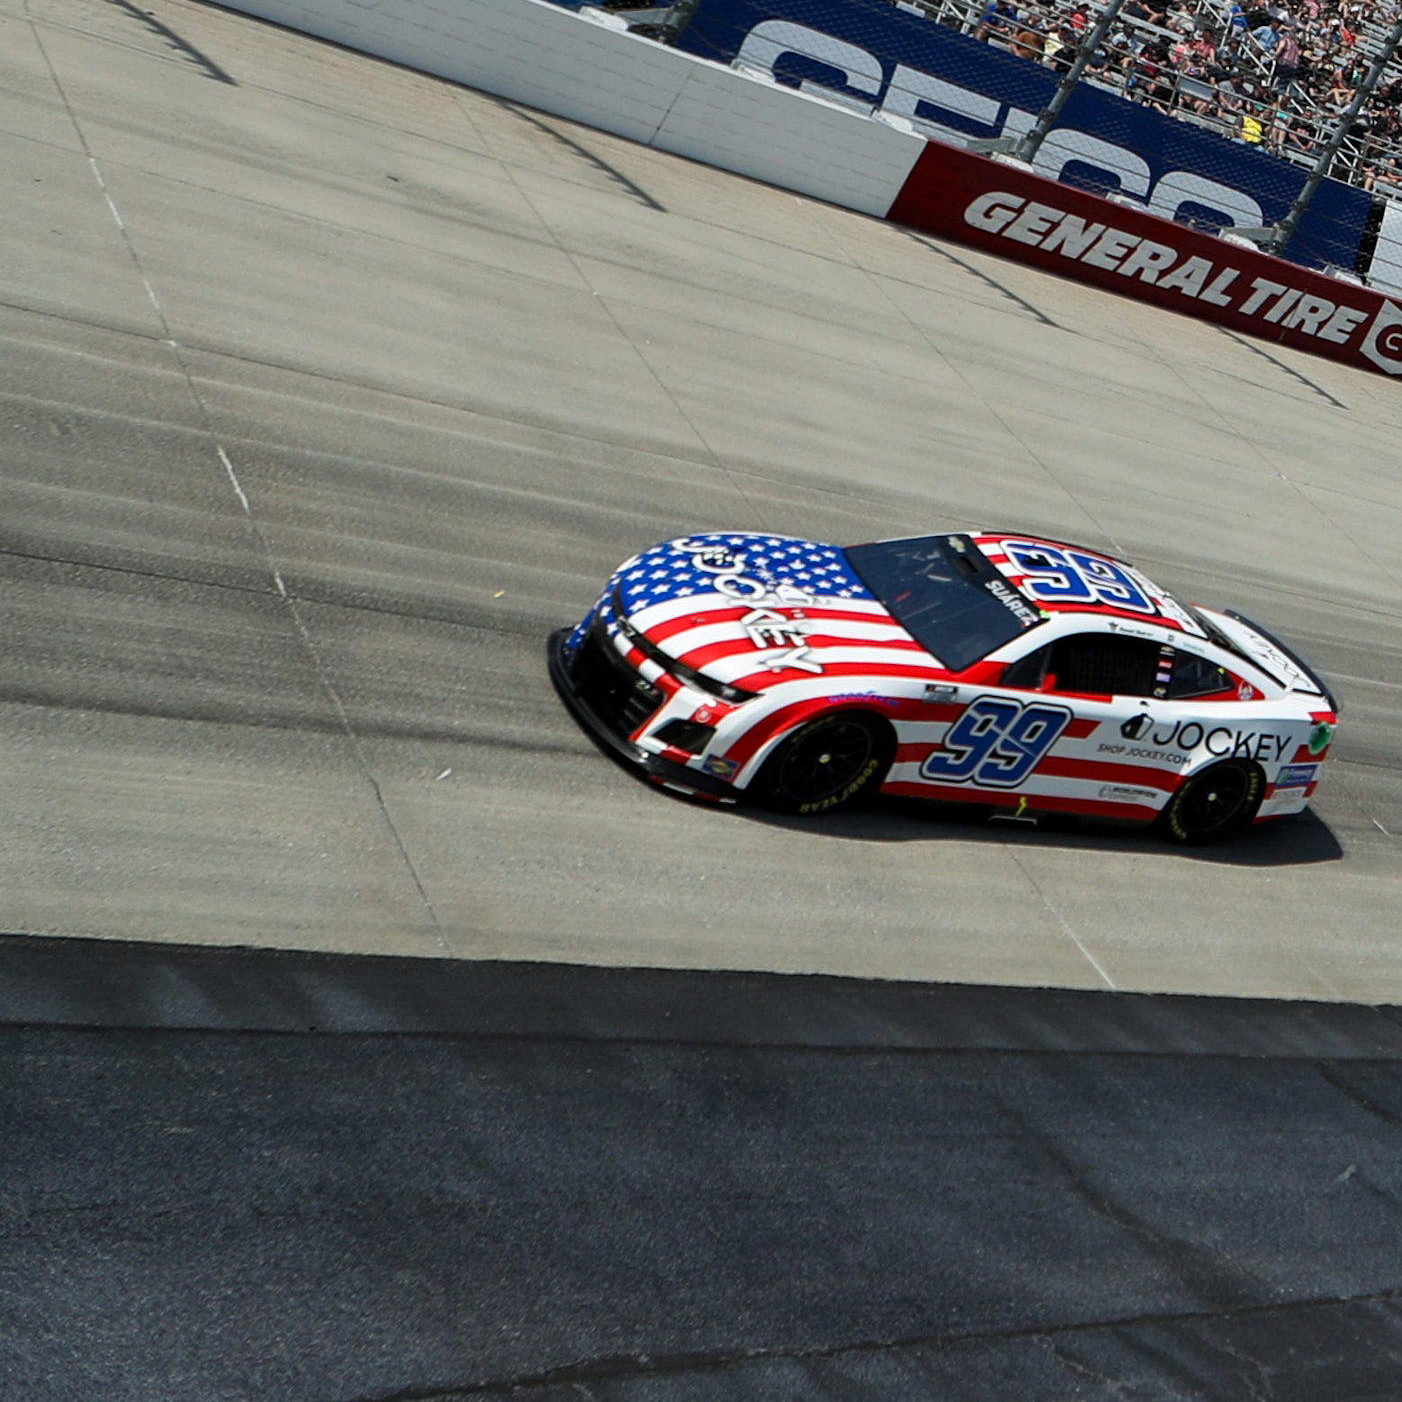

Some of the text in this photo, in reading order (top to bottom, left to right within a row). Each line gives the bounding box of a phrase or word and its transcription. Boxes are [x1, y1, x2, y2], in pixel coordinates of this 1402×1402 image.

[964, 192, 1369, 344] GENERAL TIRE
[998, 539, 1160, 616] 99
[919, 694, 1074, 788] 99
[1152, 720, 1293, 763] JOCKEY
